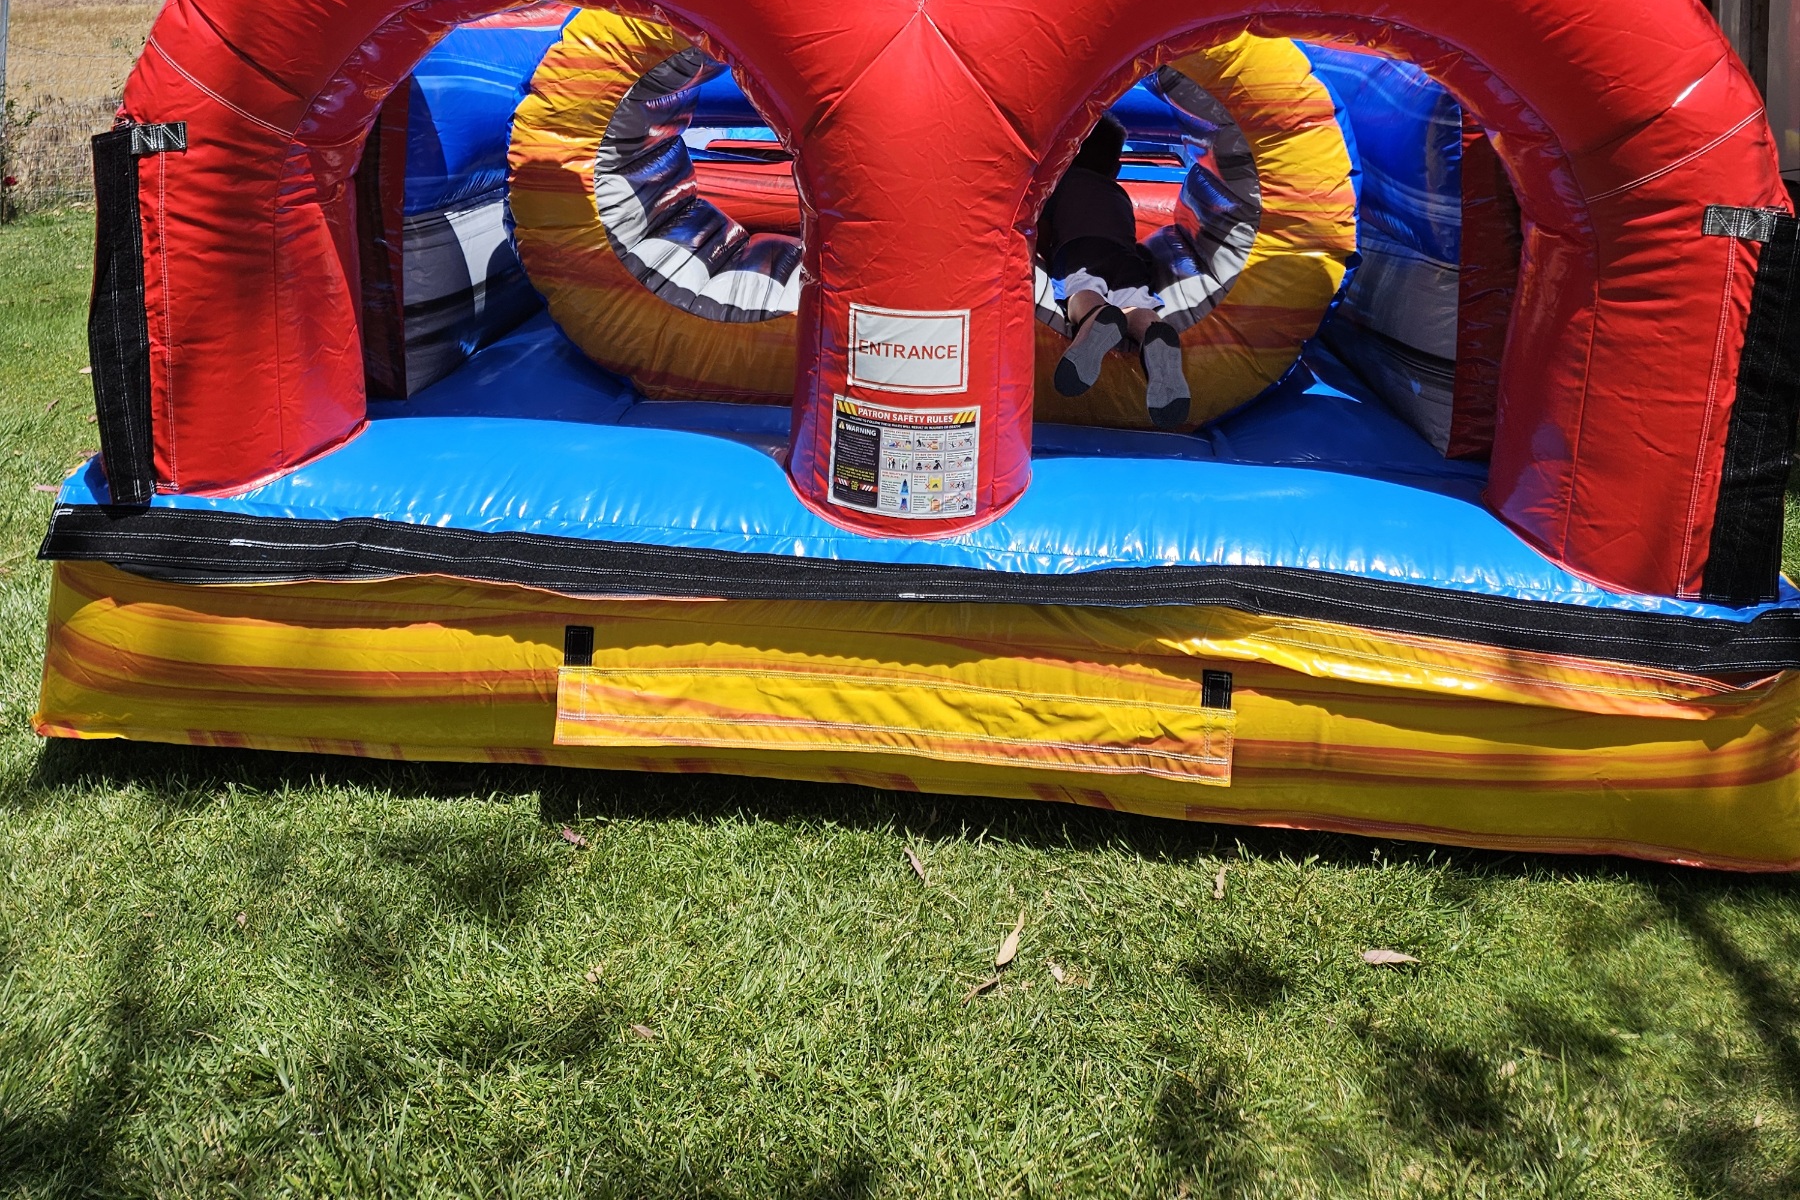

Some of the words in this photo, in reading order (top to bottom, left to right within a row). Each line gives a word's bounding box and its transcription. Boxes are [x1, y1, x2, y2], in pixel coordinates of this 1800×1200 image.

[858, 339, 958, 360] ENTRANCE
[858, 407, 891, 420] PATRON
[892, 413, 925, 423] SAFETY
[926, 414, 953, 423] RULES
[845, 423, 877, 437] WARNING
